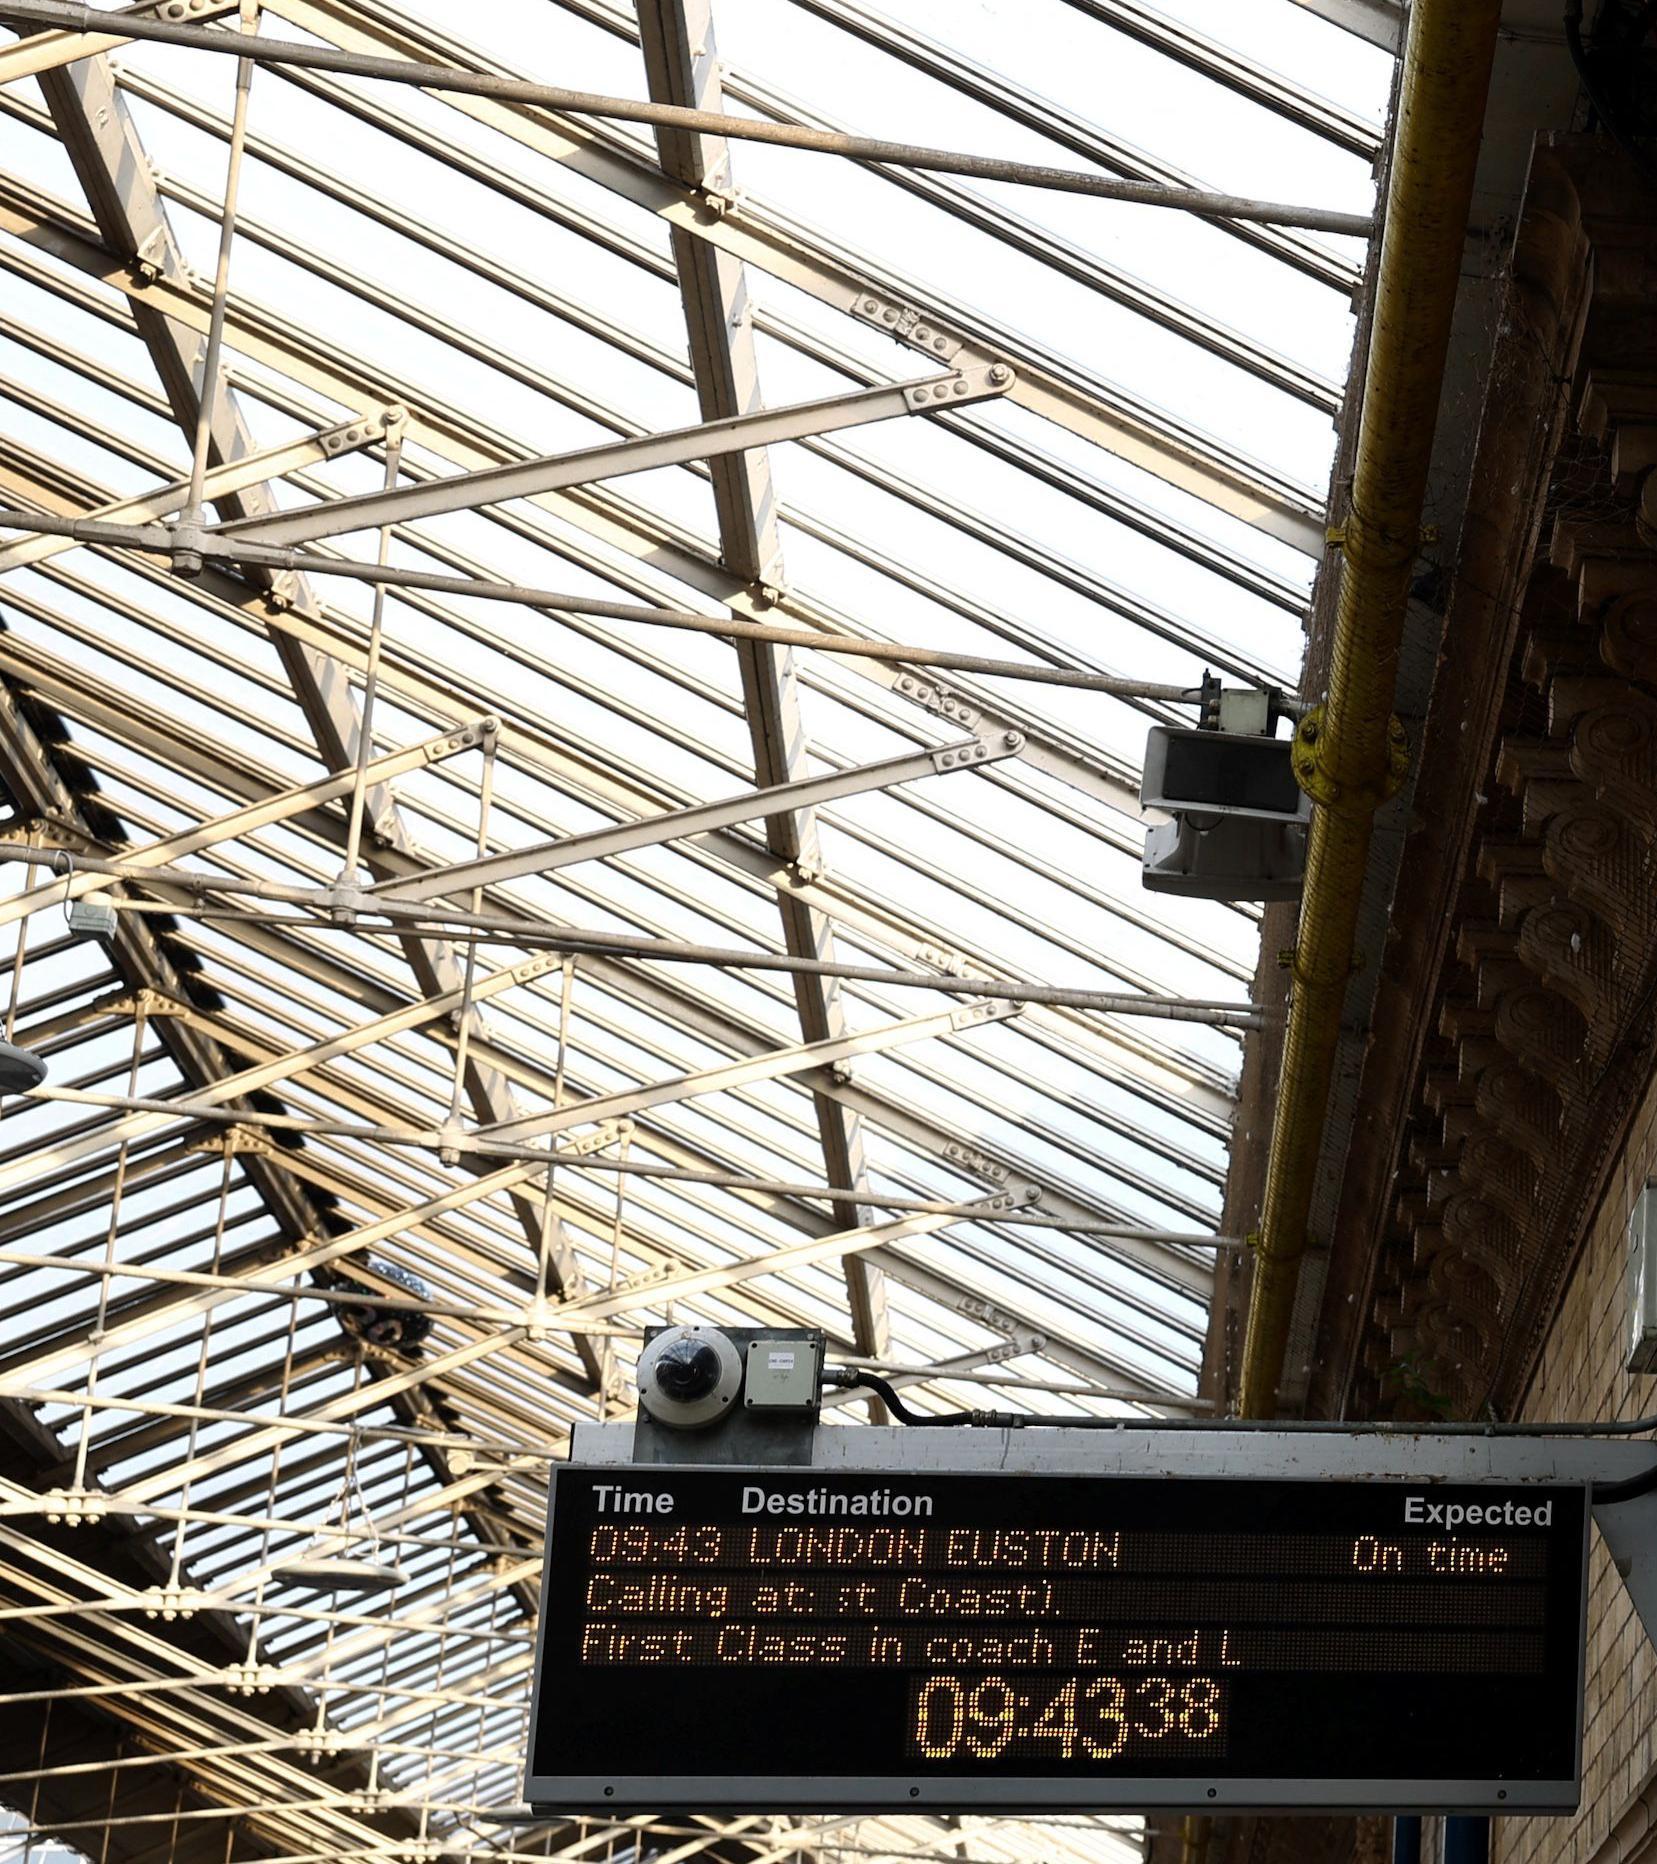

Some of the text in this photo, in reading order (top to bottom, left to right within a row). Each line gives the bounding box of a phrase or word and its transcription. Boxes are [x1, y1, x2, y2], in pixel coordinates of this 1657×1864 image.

[592, 1485, 933, 1516] Time Destination
[1404, 1497, 1552, 1530] Expected
[590, 1525, 1120, 1568] 09:43 LONDON EUSTON
[1352, 1535, 1508, 1573] On time
[586, 1574, 728, 1618] Calling
[751, 1581, 814, 1613] at:
[582, 1623, 1241, 1666] First Class in coach E and L
